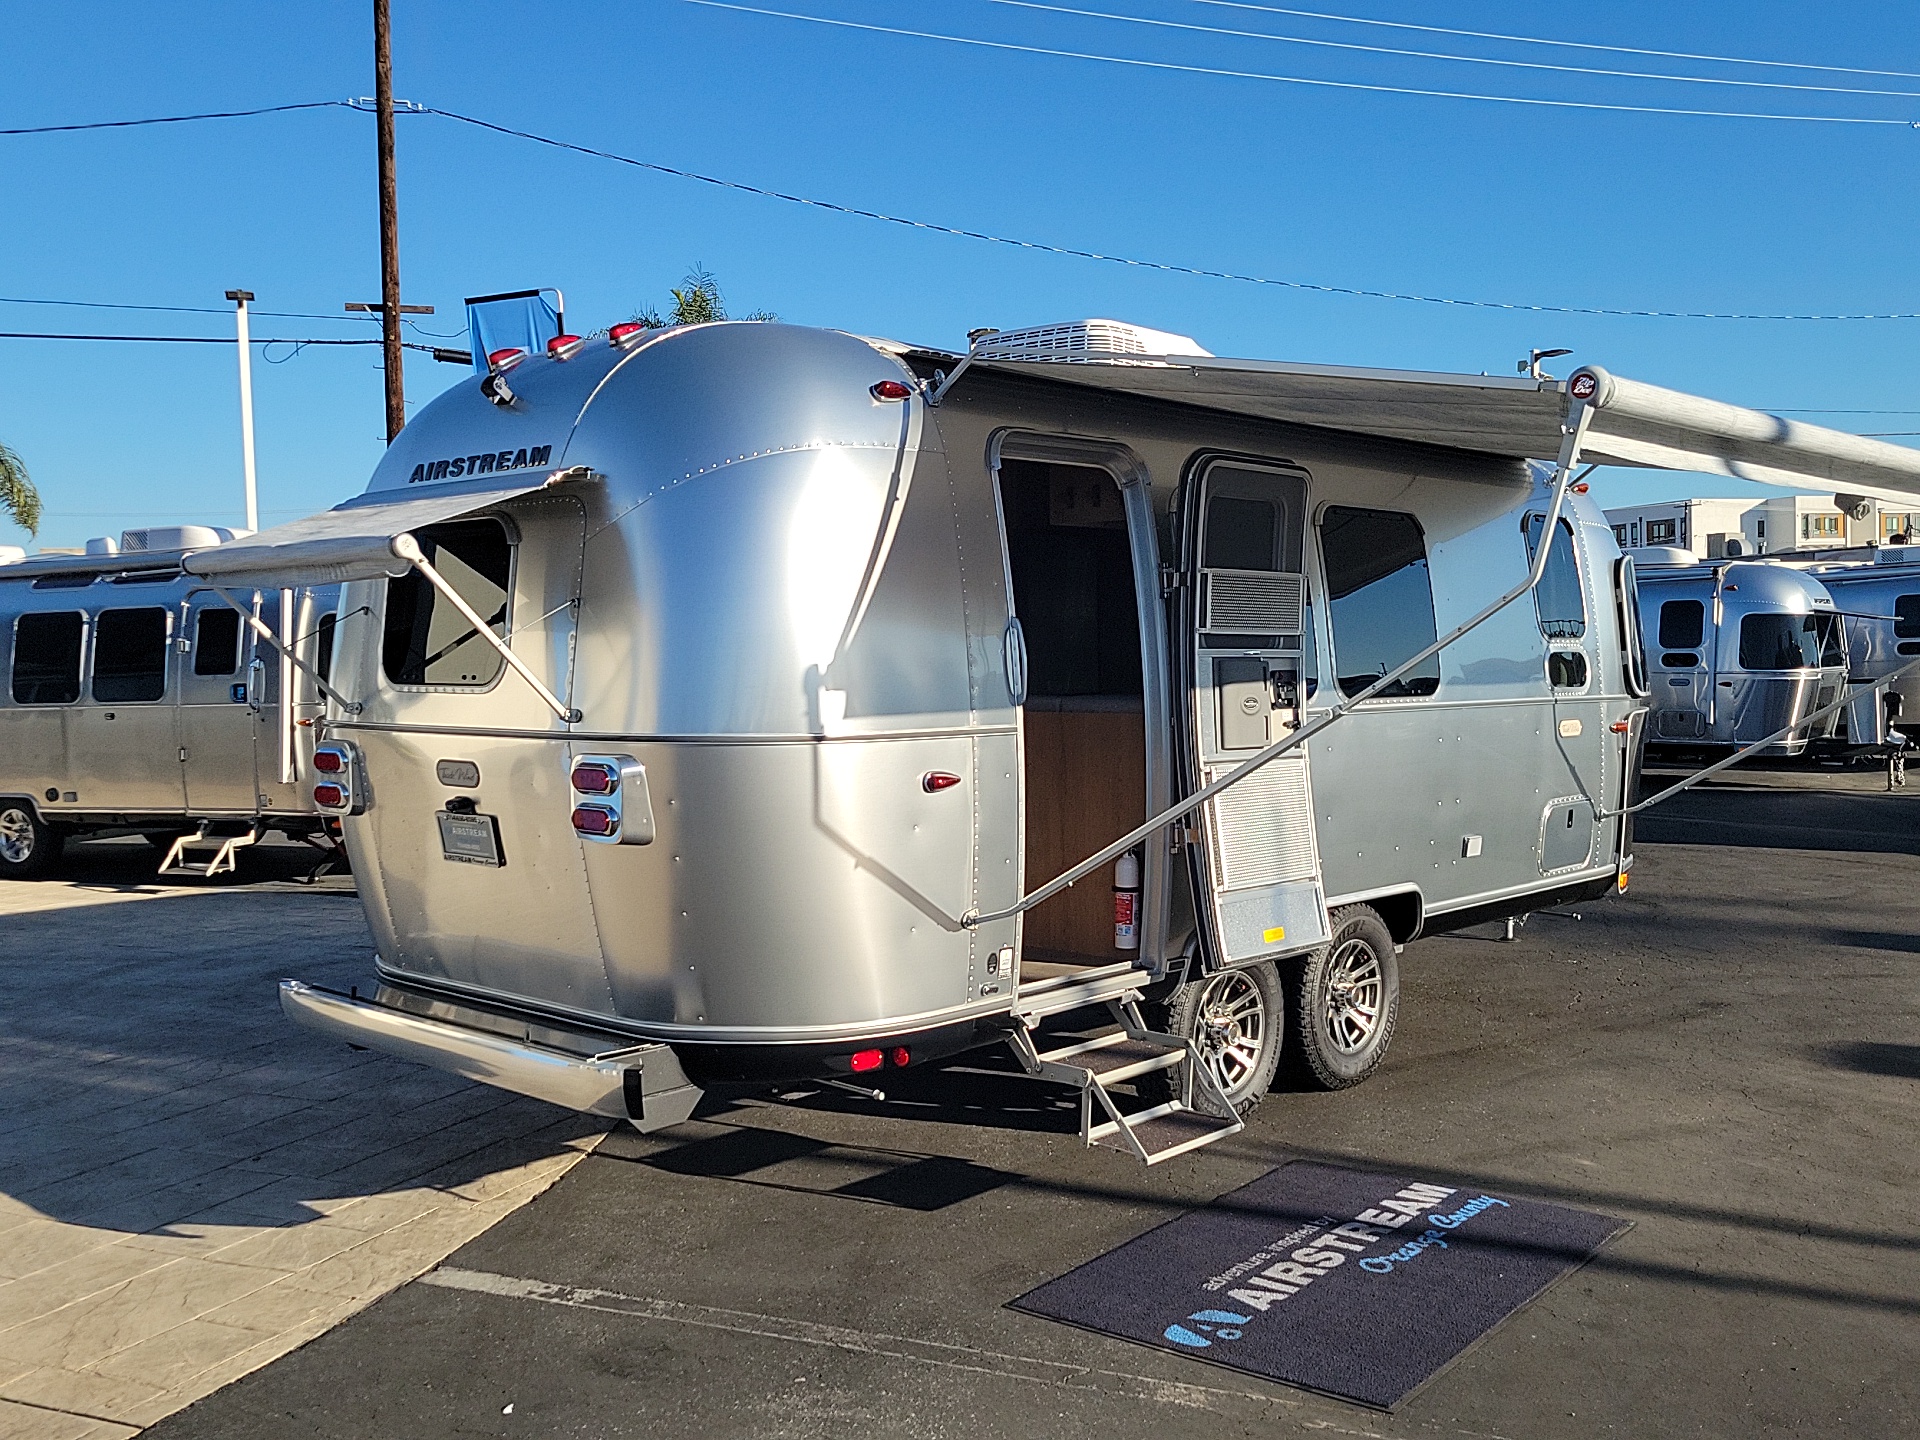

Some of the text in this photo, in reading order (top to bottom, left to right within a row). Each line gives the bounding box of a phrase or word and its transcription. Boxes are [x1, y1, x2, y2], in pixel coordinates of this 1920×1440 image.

[1573, 385, 1593, 394] Dee
[1576, 377, 1595, 387] Zip
[409, 445, 552, 483] AIRSTREAM
[1227, 1182, 1458, 1311] AIRSTREAM
[1359, 1195, 1510, 1274] Orange County
